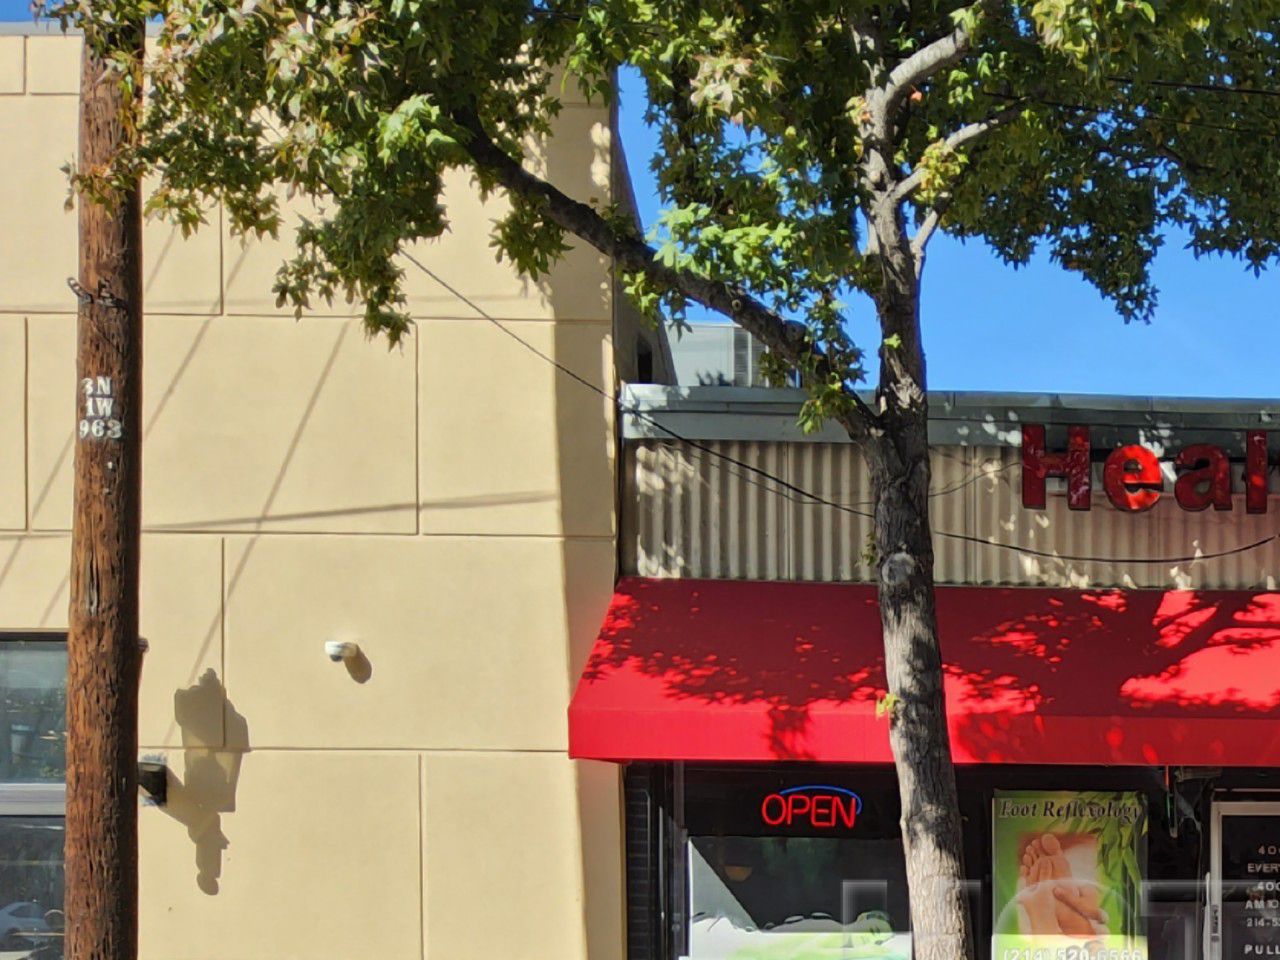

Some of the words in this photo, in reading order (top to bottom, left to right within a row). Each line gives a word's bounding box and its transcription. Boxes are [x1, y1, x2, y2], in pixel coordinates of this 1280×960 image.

[80, 419, 122, 439] 963
[761, 793, 857, 829] OPEN
[1000, 799, 1037, 818] Foot
[1042, 799, 1142, 825] Reflexology
